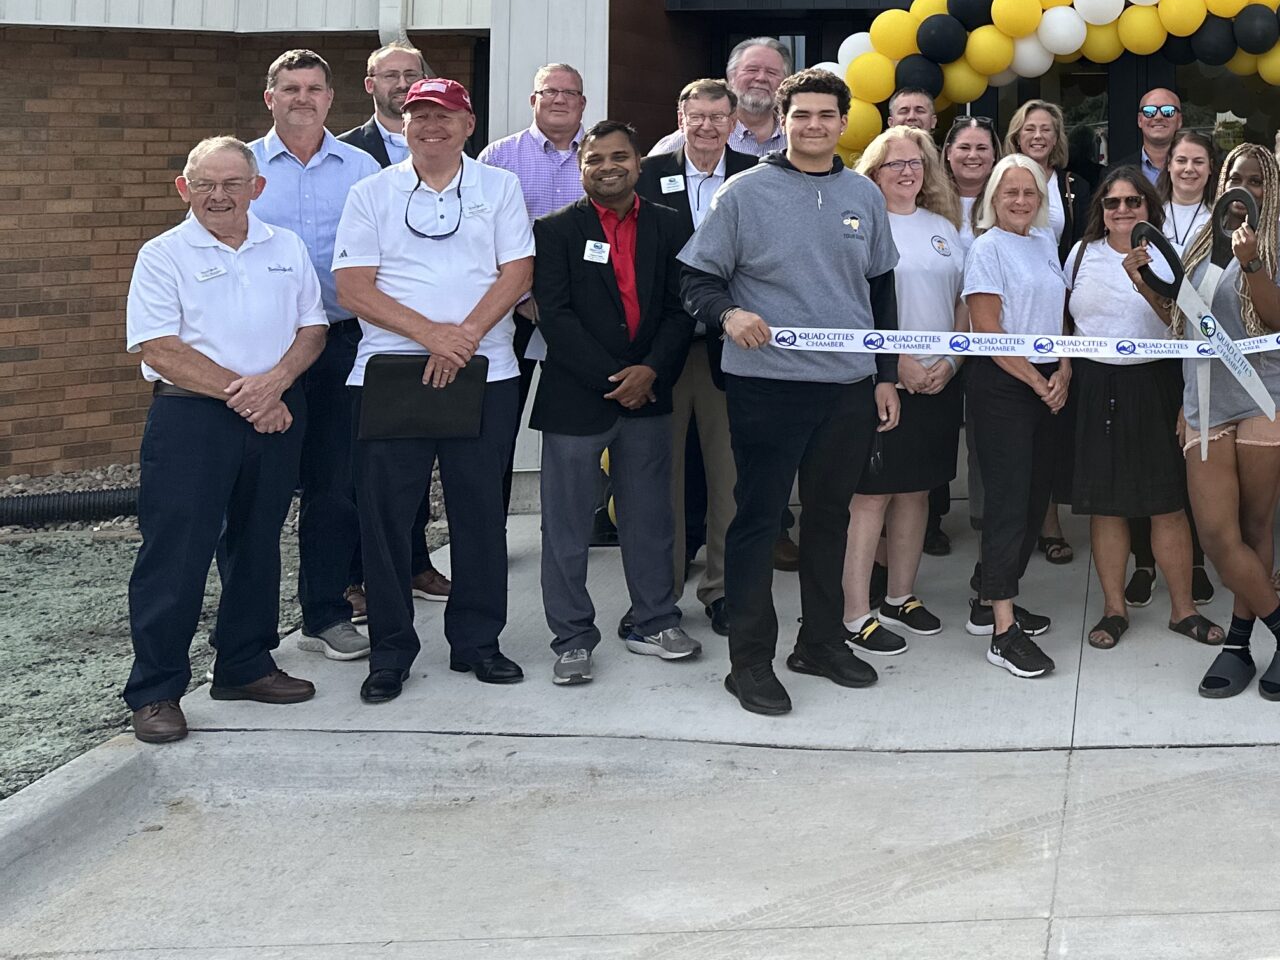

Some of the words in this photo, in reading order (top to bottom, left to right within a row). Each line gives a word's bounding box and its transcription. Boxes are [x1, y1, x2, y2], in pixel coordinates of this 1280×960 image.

[798, 332, 826, 341] QUAD
[827, 332, 854, 341] CITIES
[914, 335, 941, 343] CITIES
[999, 337, 1026, 345] CITIES
[1216, 332, 1235, 354] QUAD
[1234, 352, 1252, 377] CITIES
[1216, 344, 1242, 375] CHAMBER
